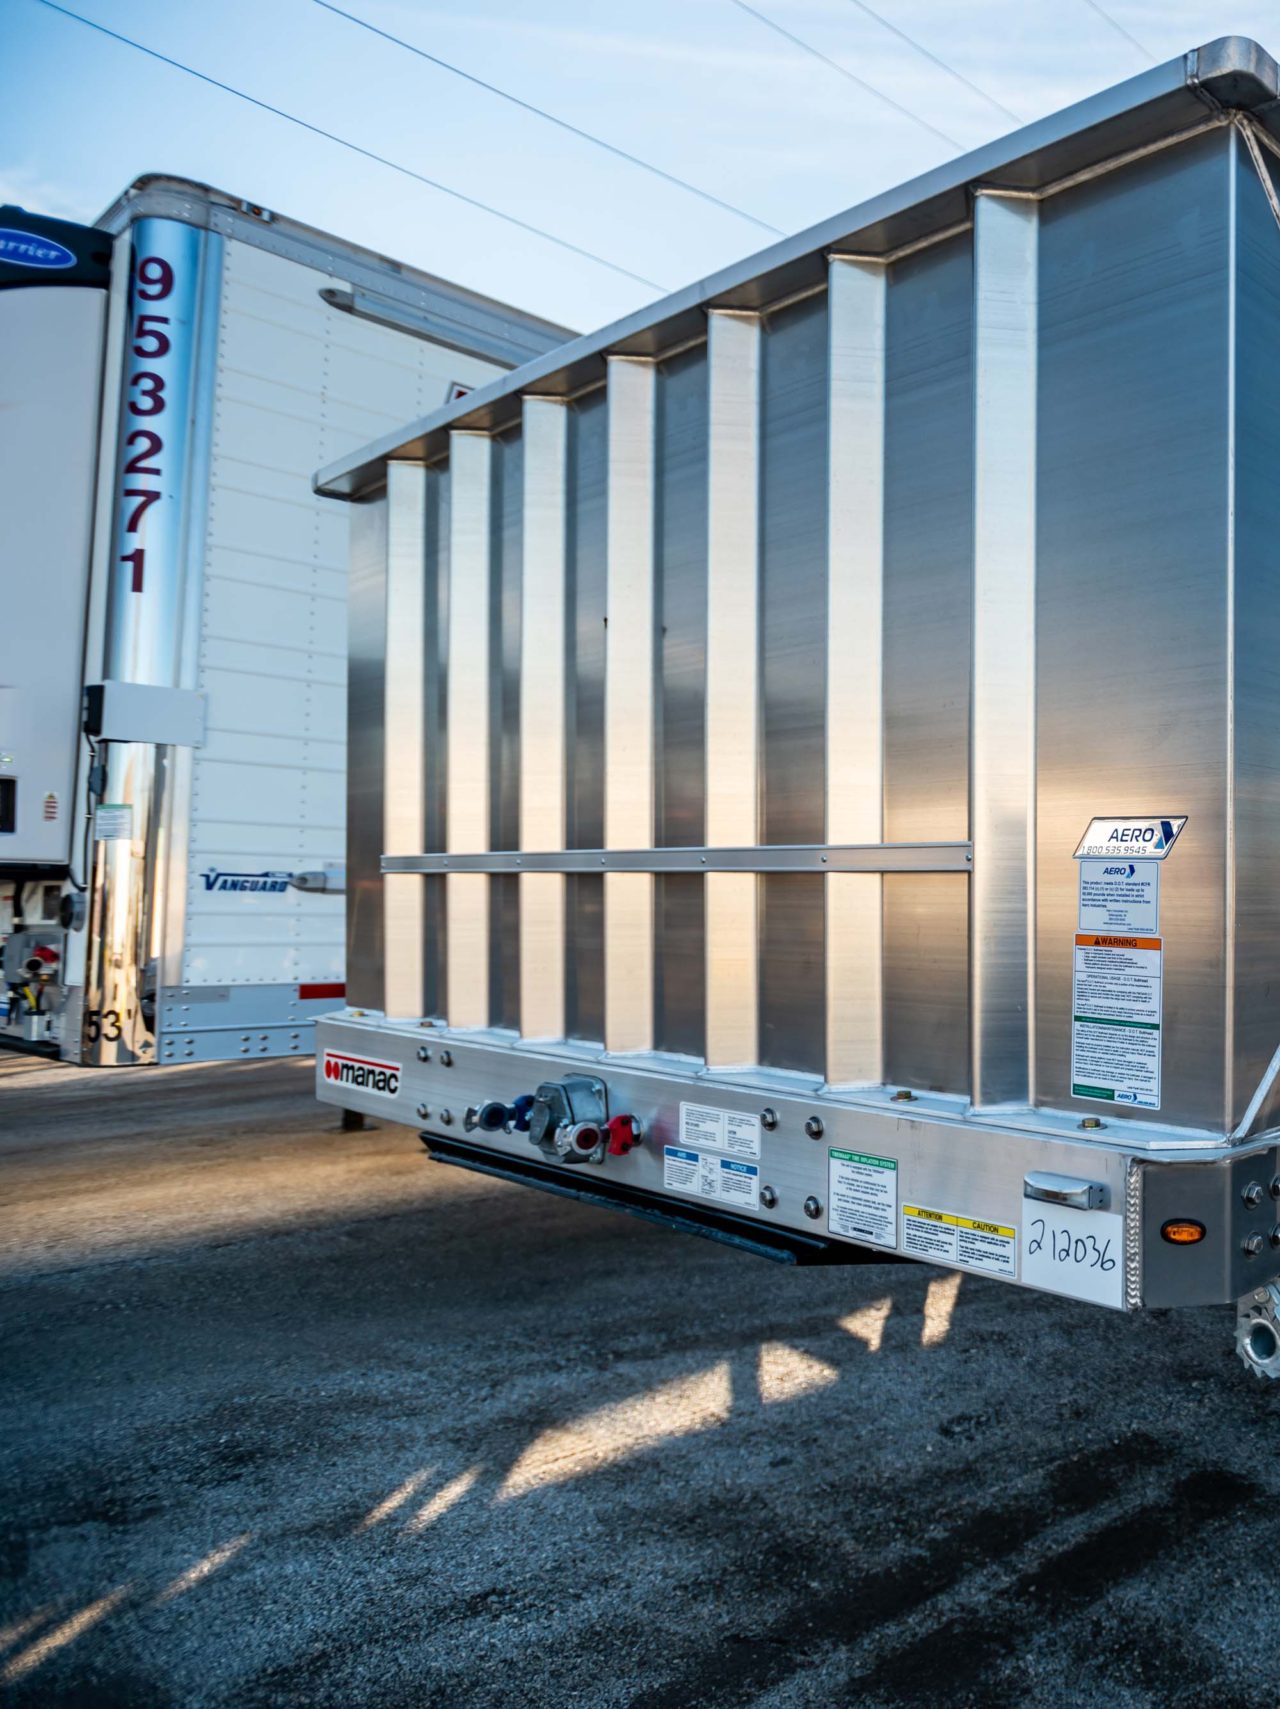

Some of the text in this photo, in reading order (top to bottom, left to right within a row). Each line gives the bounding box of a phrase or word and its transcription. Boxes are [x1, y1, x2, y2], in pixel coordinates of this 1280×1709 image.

[119, 256, 175, 594] 953271
[1107, 828, 1155, 842] AERO
[1102, 867, 1127, 875] AERO
[1100, 937, 1137, 948] WARNING
[340, 1062, 399, 1094] manac
[972, 1221, 999, 1234] CAUTION
[1029, 1219, 1116, 1271] 212036
